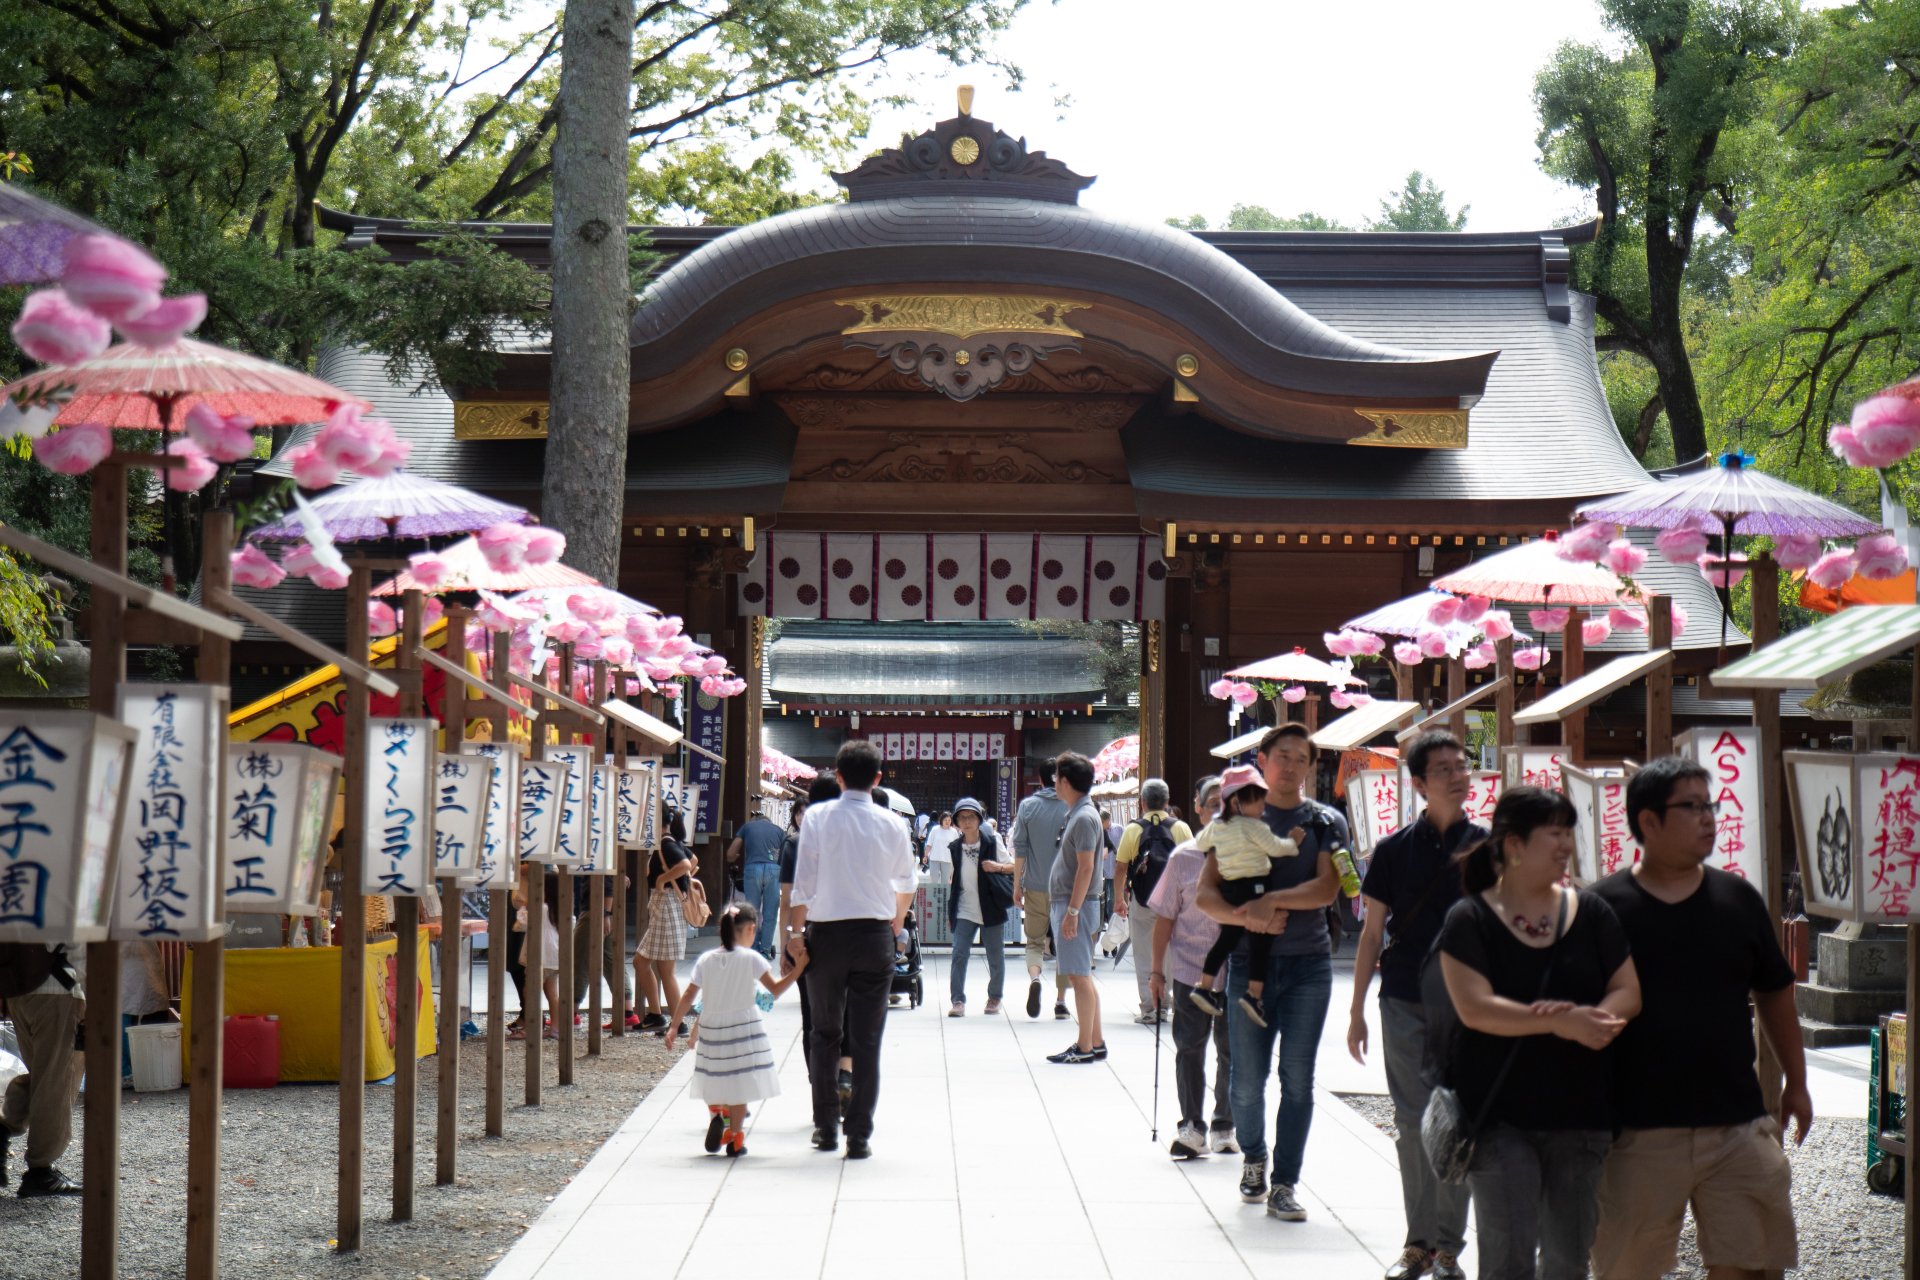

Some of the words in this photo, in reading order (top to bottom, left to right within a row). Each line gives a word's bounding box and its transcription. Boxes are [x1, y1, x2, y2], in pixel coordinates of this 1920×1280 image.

[0, 726, 67, 929] 金子園
[699, 715, 712, 791] 天皇陛御即位
[1867, 757, 1920, 918] 内藤提灯店
